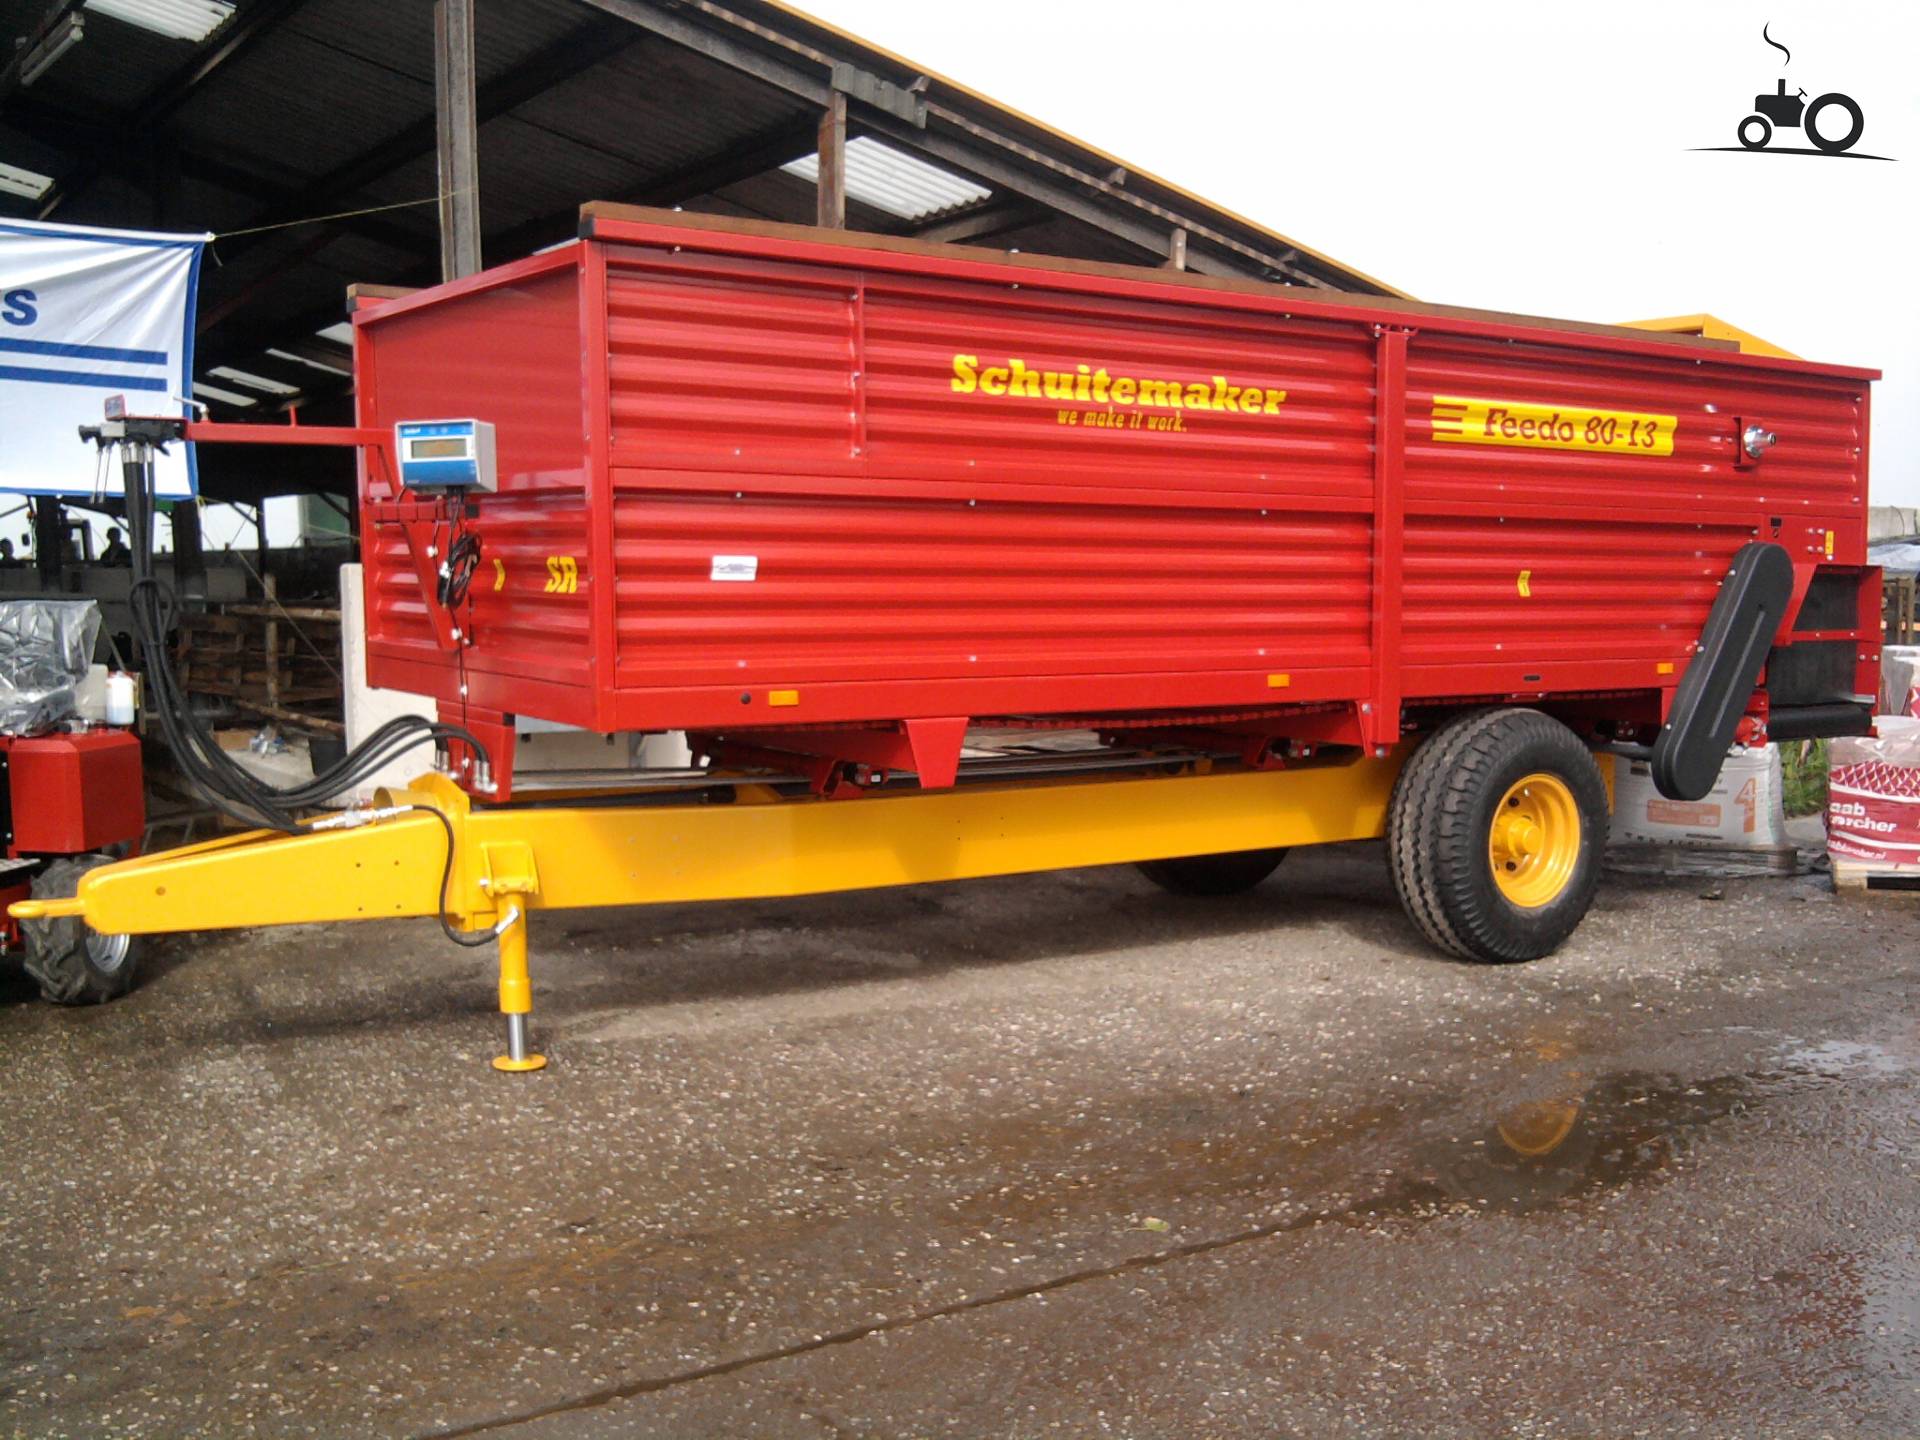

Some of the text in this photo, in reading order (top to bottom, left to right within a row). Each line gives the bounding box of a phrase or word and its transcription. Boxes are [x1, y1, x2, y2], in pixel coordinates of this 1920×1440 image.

[950, 354, 1287, 415] Schuitemaker
[1057, 405, 1188, 432] we make it work.
[1483, 408, 1658, 448] Feedo 80-13
[1829, 802, 1866, 816] aab
[1829, 816, 1897, 833] archer
